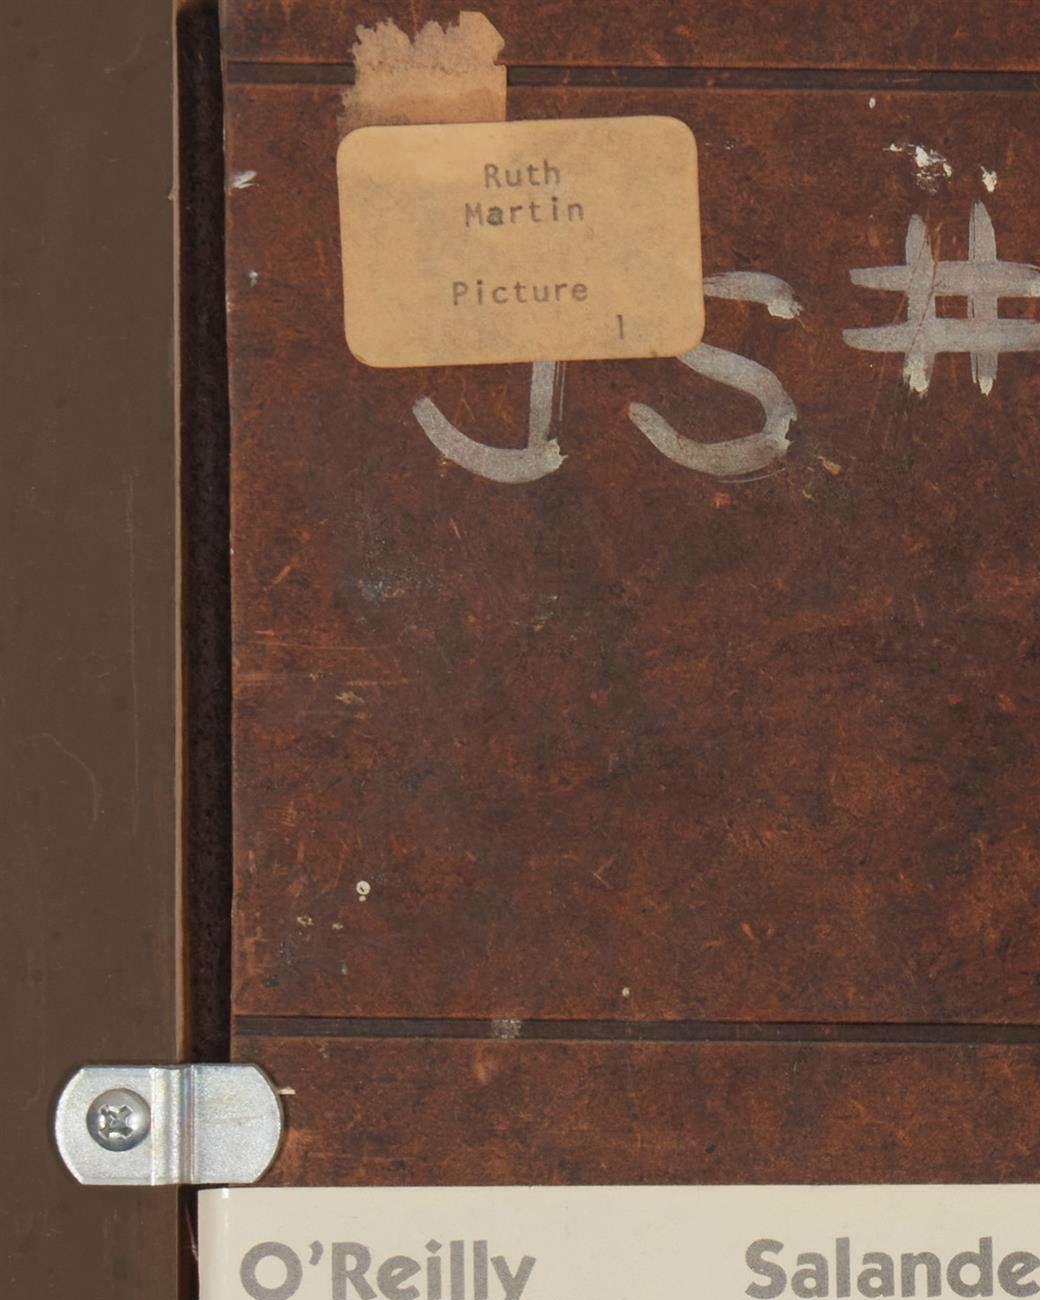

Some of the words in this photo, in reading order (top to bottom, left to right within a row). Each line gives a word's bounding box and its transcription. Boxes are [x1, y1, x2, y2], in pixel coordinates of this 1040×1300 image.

[483, 158, 561, 189] Ruth
[463, 196, 585, 227] Martin
[451, 279, 589, 306] Picture
